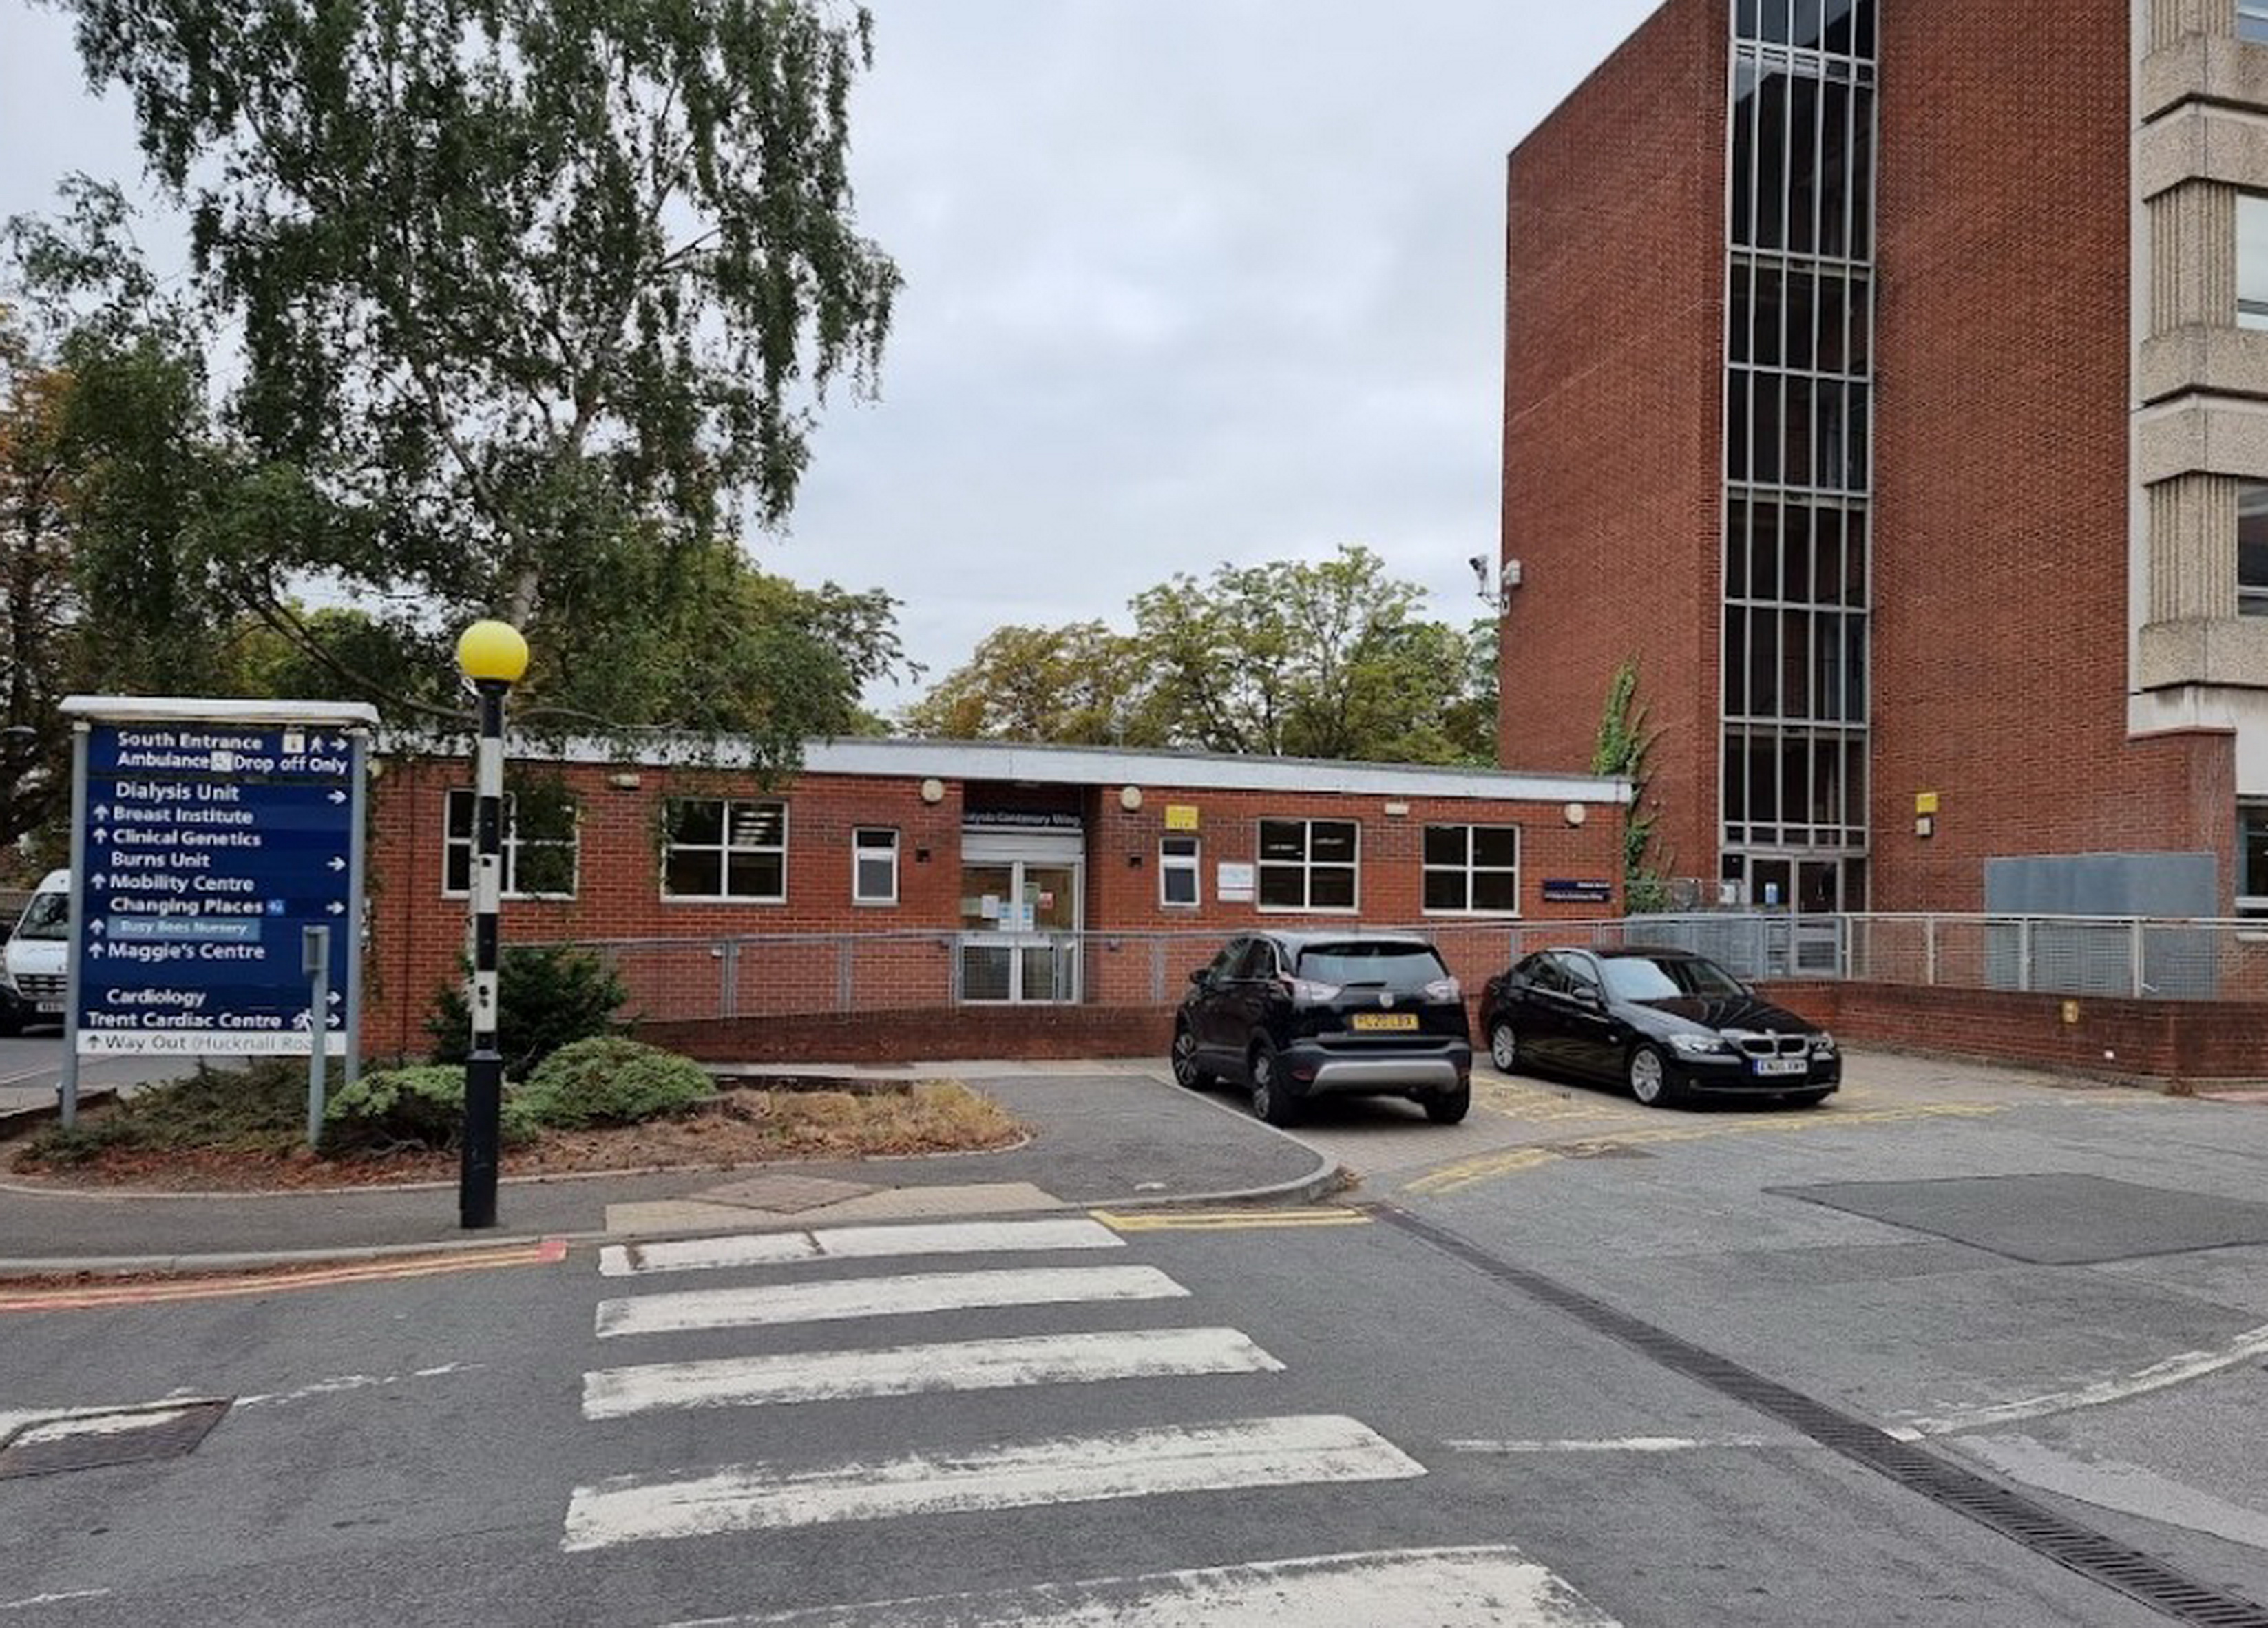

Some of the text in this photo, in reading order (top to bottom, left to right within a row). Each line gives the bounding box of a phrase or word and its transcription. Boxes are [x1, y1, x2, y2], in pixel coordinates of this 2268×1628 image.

[118, 731, 262, 750] South Entrance
[117, 751, 347, 775] Ambulance Drop off Only
[116, 781, 240, 803] Dialysis Unit
[113, 805, 253, 825] Breast Institute
[112, 828, 262, 847] Clinical Genetics
[111, 852, 211, 868] Burns Unit
[110, 874, 255, 894] Mobility Centre
[110, 896, 264, 916] Changing Places
[120, 920, 154, 935] Busy
[194, 922, 248, 937] Nursery
[107, 942, 265, 961] Maggie's Centre
[107, 989, 206, 1008] Cardiology
[87, 1011, 282, 1028] Trent Cardiac Centre
[105, 1035, 146, 1051] Way
[152, 1036, 185, 1050] Out
